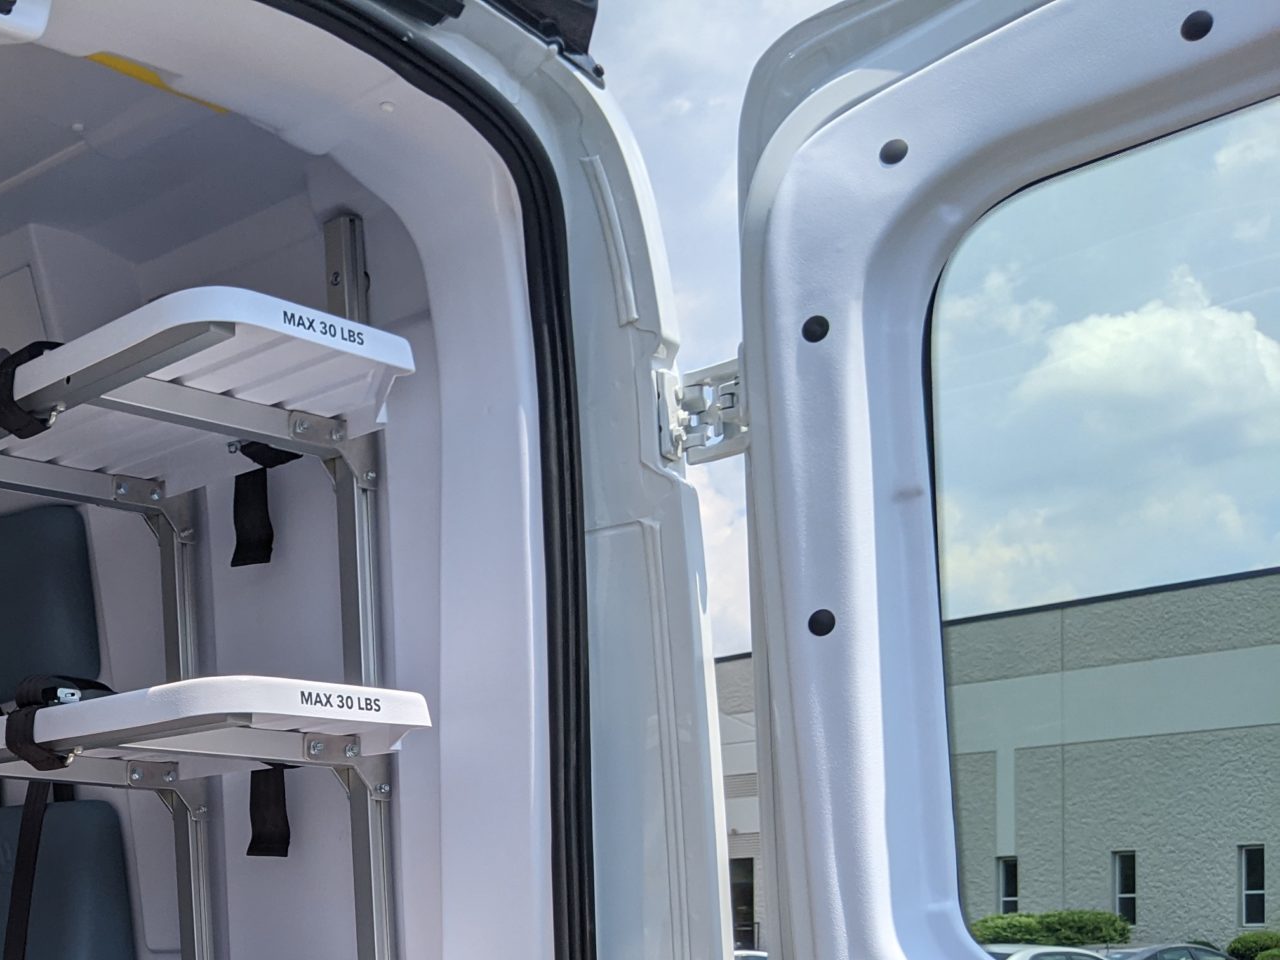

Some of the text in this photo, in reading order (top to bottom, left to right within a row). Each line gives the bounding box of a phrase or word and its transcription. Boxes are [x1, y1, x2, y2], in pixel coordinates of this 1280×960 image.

[283, 311, 365, 346] MAX 30 LBS
[300, 690, 381, 712] MAX 30 LBS
